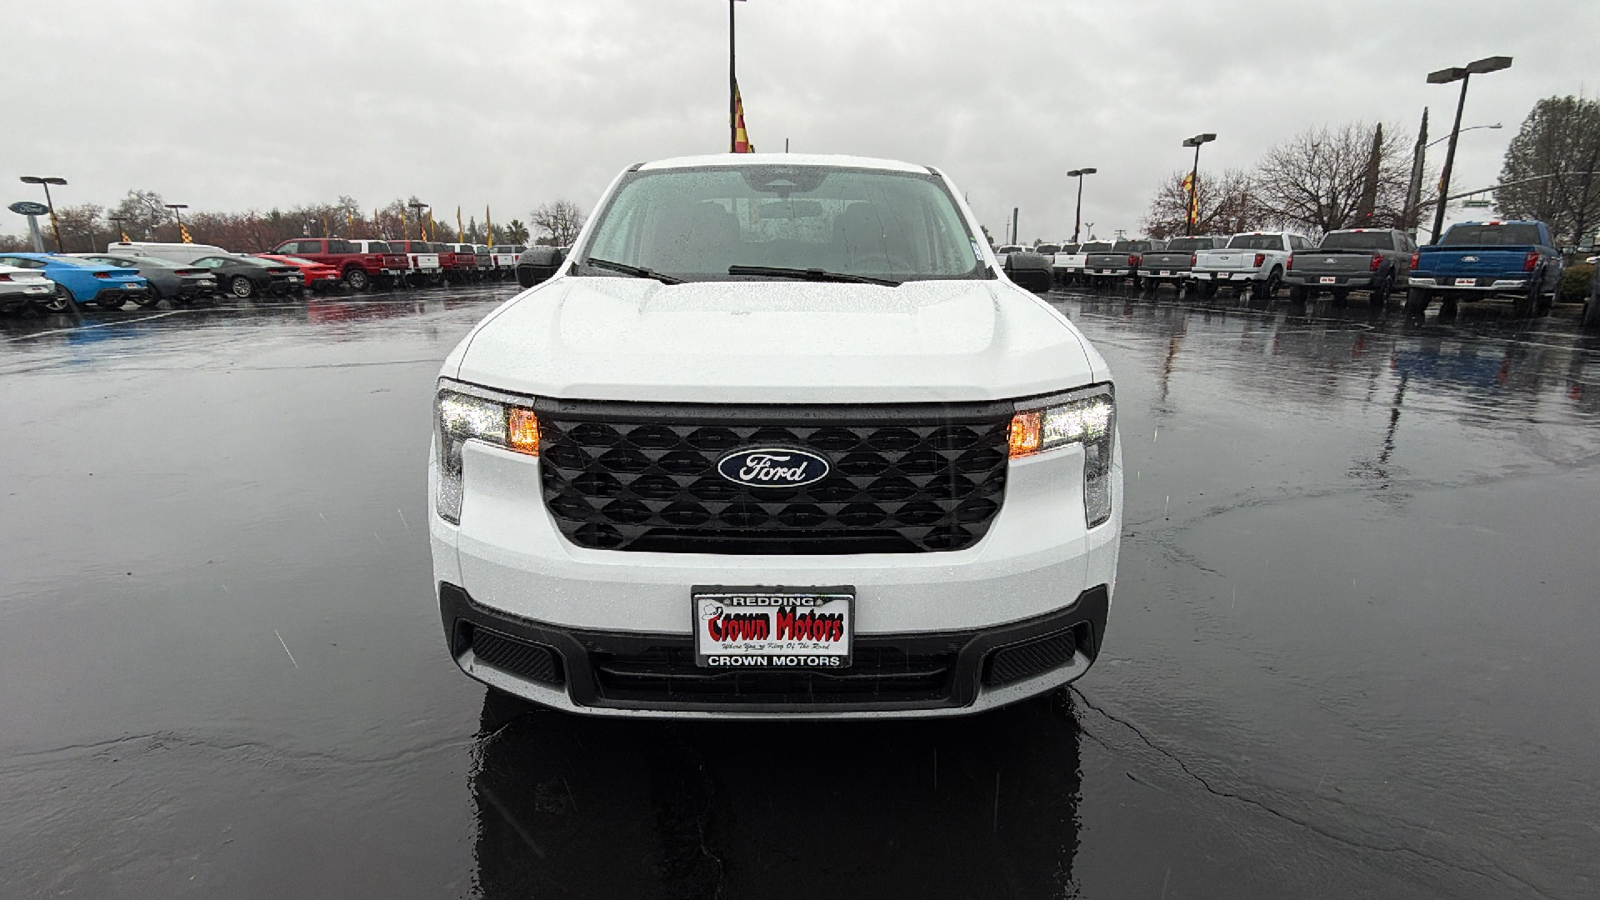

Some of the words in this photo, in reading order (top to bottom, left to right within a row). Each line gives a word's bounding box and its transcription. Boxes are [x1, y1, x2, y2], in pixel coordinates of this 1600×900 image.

[739, 454, 808, 480] Ford
[733, 597, 814, 606] REDDING
[708, 607, 770, 642] Crown
[776, 605, 844, 642] Motors
[767, 642, 783, 650] King
[786, 642, 795, 650] Of
[708, 656, 767, 666] CROWN
[773, 656, 840, 666] MOTORS
